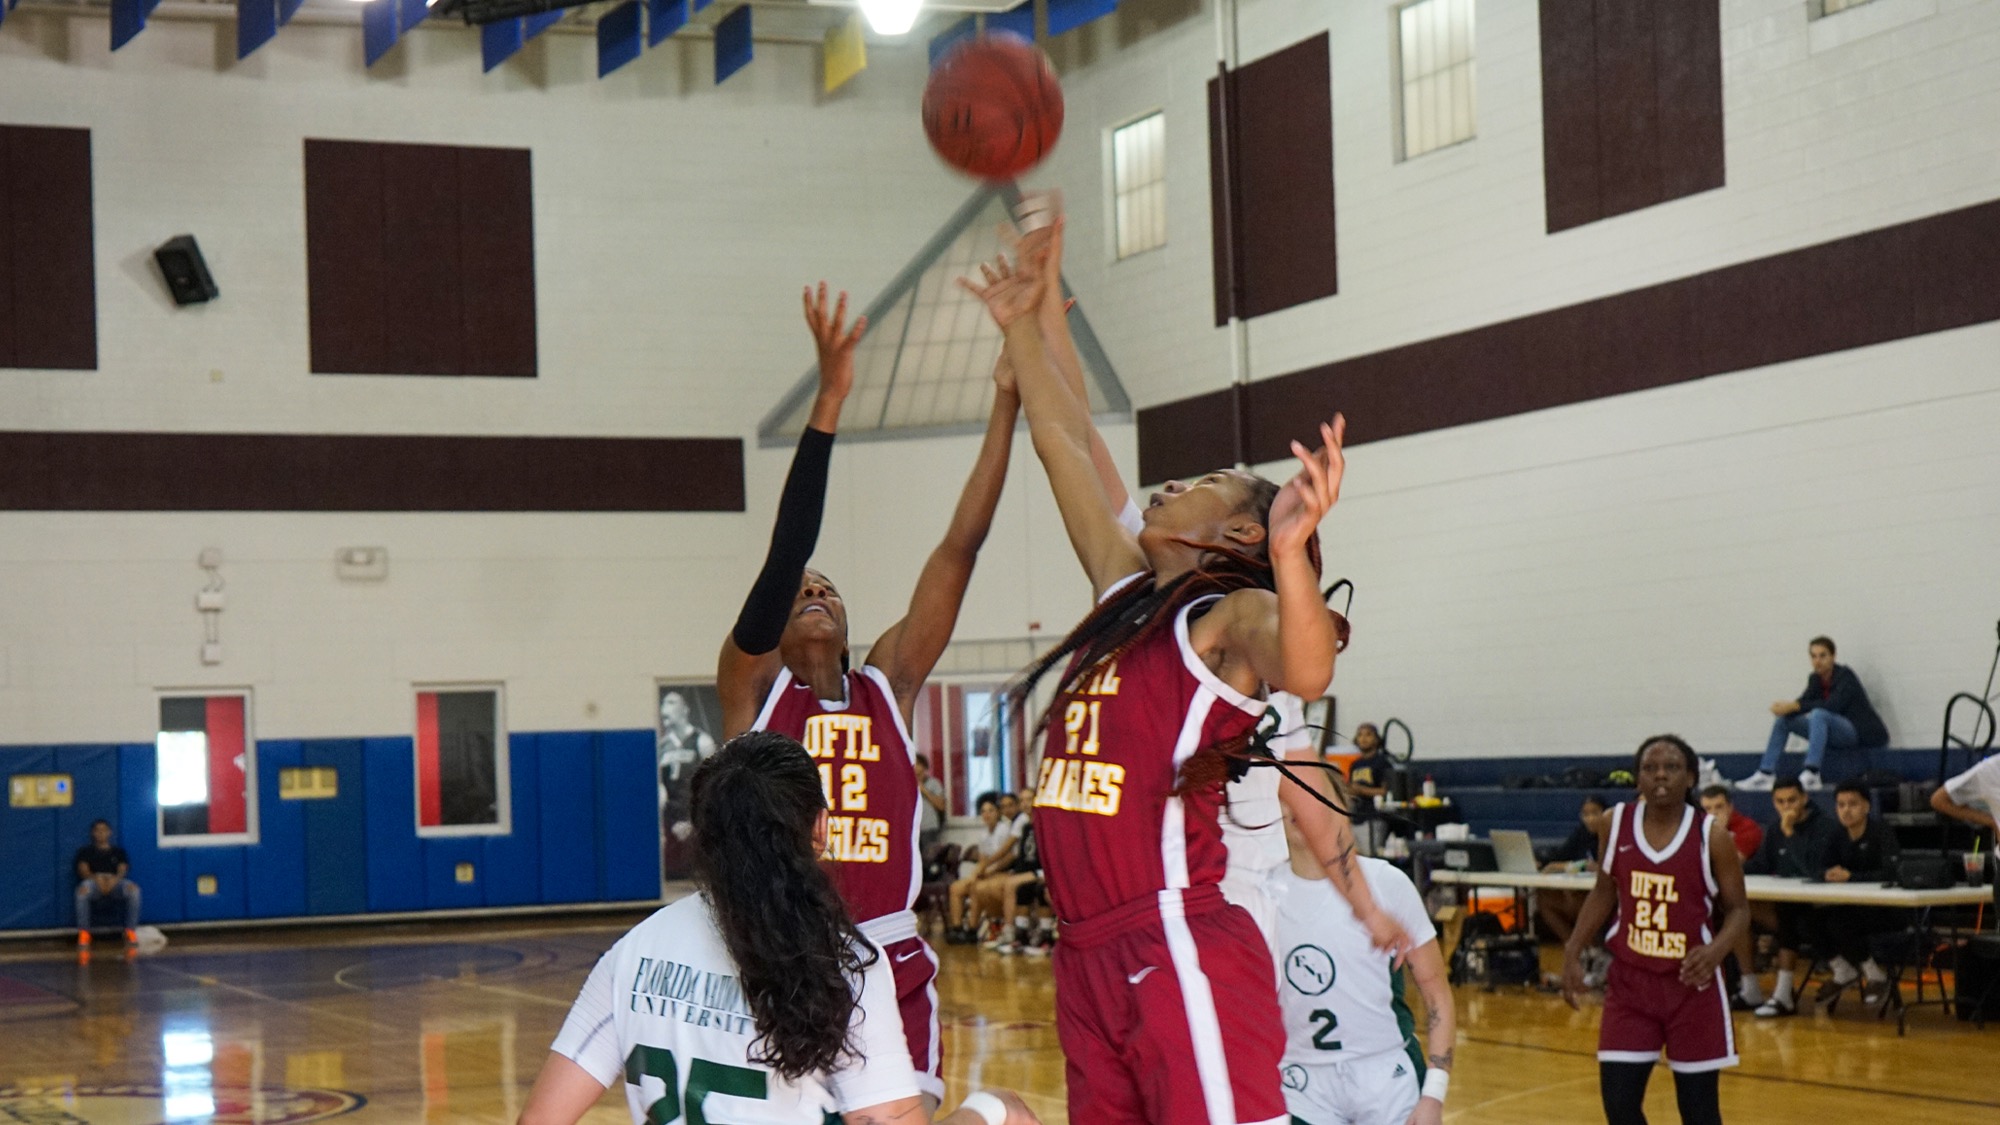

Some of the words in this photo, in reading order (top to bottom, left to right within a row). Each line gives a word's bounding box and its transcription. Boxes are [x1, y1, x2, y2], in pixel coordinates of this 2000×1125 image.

[803, 714, 881, 762] UFTL
[818, 763, 868, 812] 12
[820, 816, 890, 863] GLES
[1630, 870, 1679, 903] UFTL
[1635, 899, 1668, 932] 24
[630, 993, 750, 1036] UNIVERSIT
[1309, 1008, 1342, 1050] 2
